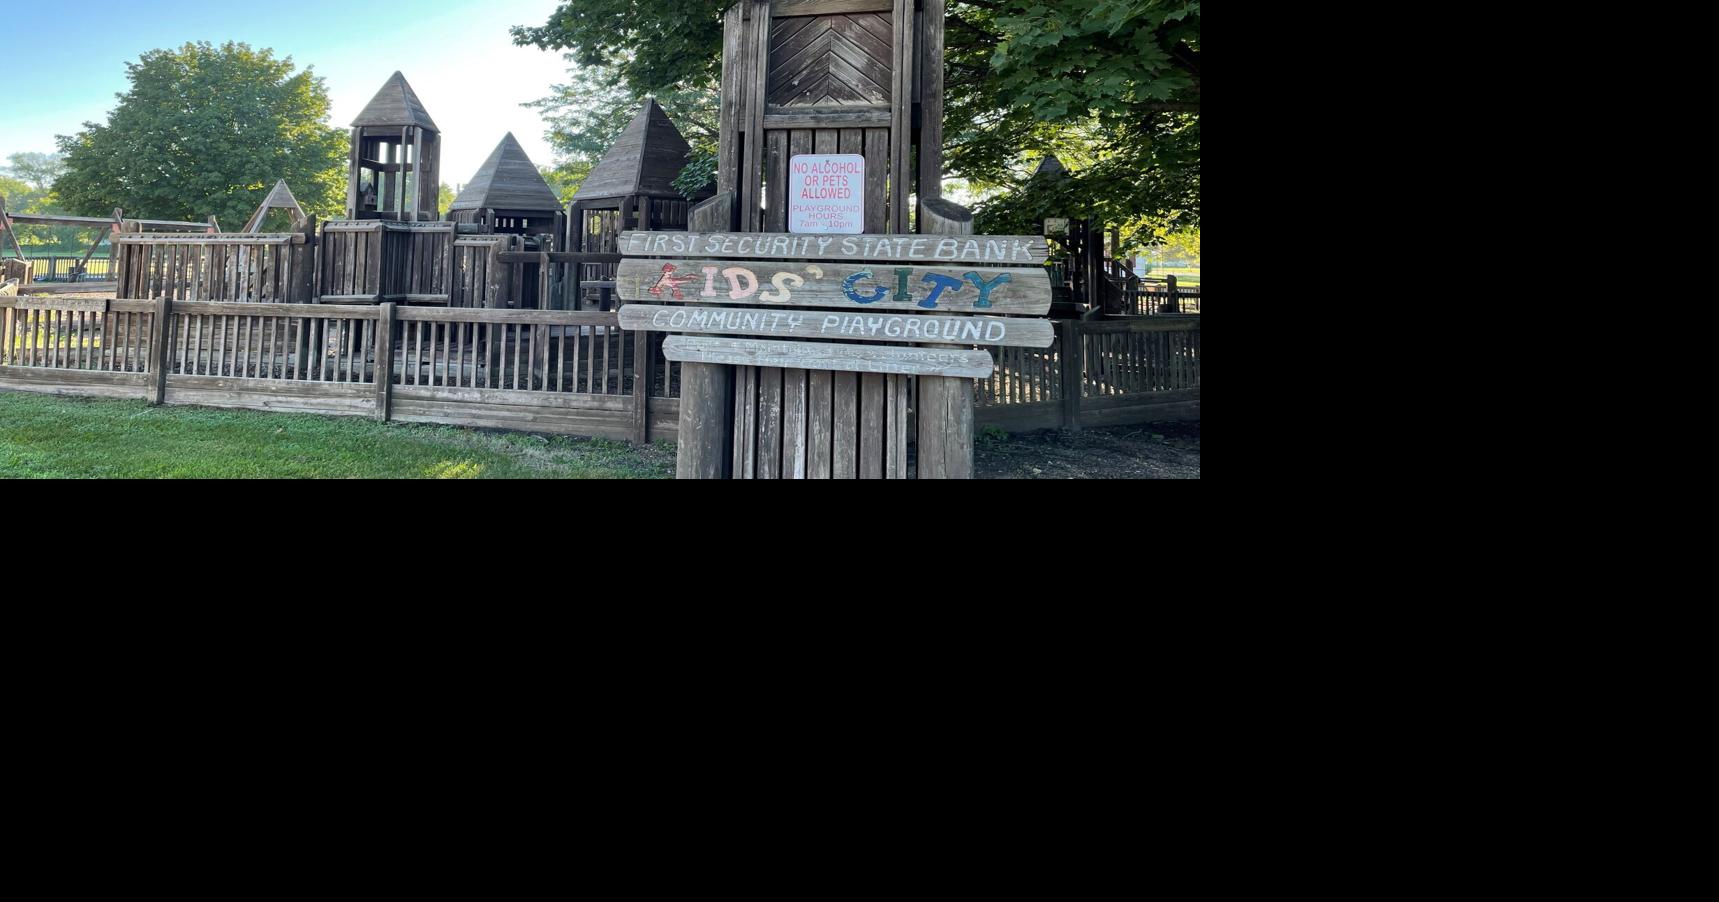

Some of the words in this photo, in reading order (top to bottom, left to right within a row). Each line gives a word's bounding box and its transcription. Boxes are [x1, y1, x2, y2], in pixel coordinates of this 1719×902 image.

[793, 163, 808, 173] NO
[812, 162, 860, 173] ALCOHOL
[805, 175, 819, 186] OR
[822, 175, 848, 186] PETS
[801, 187, 851, 199] ALLOWED
[793, 204, 860, 212] PLAYGROUND
[829, 220, 853, 228] 10pm
[627, 233, 701, 252] FIRST
[705, 235, 833, 256] SECURITY
[841, 237, 928, 258] STATE
[934, 239, 1034, 261] BANK
[841, 266, 1013, 309] CITY
[652, 309, 804, 333] COMMUNITY
